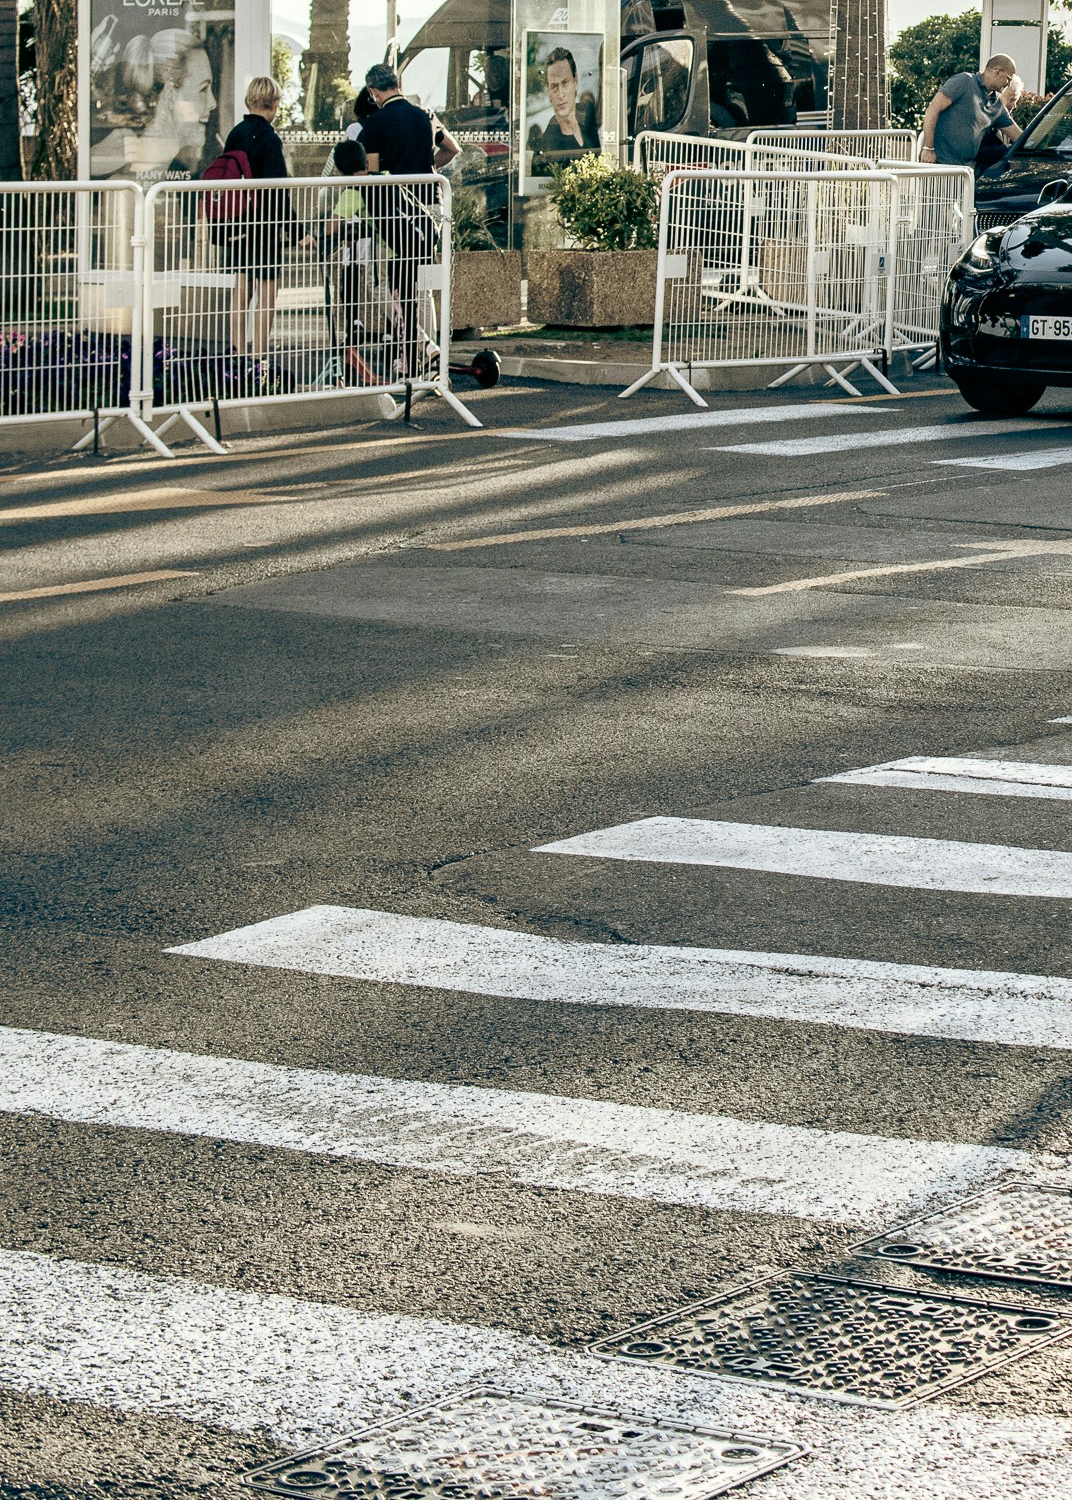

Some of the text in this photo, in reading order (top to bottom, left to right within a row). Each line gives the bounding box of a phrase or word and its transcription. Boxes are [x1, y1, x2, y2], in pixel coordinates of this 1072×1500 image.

[148, 8, 180, 16] PARIS
[136, 170, 192, 180] MANY WAYS
